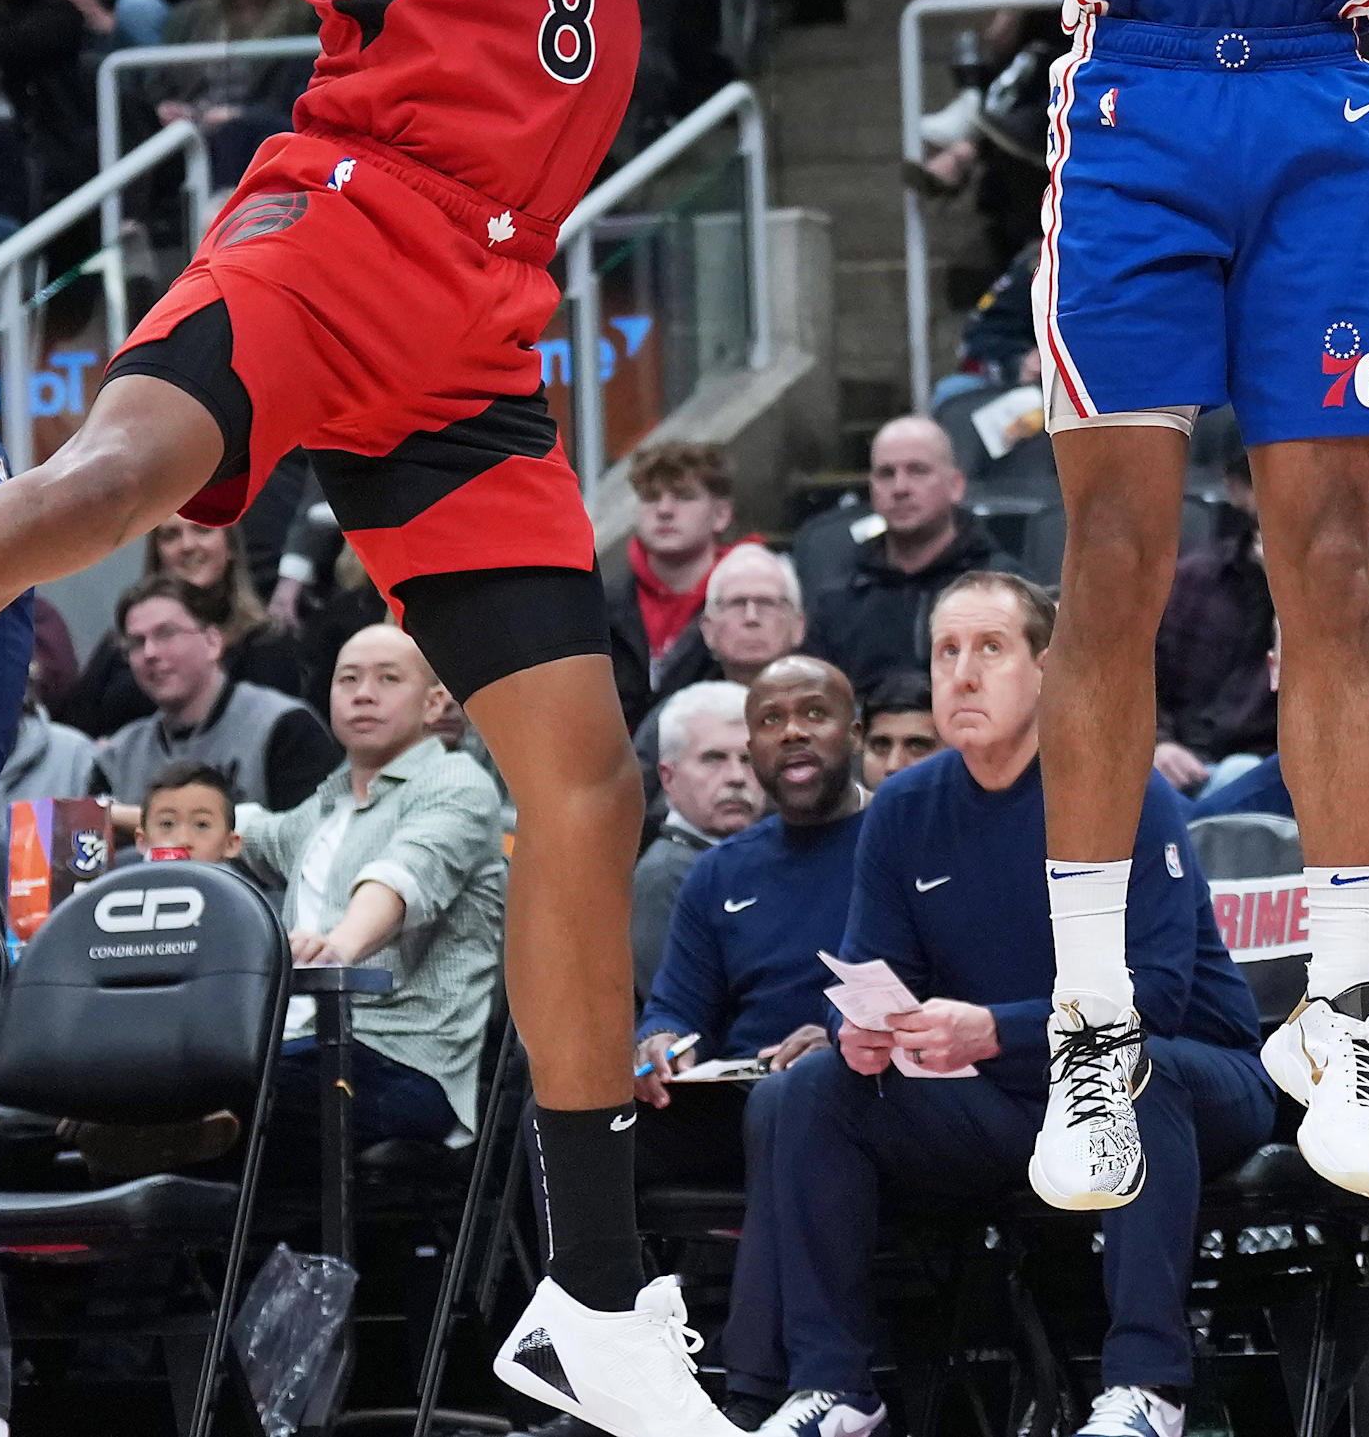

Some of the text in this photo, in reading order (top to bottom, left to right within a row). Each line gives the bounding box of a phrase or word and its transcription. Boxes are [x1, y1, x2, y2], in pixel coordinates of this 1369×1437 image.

[1213, 886, 1310, 949] RIME
[89, 940, 198, 960] CONDRAIN GROUP
